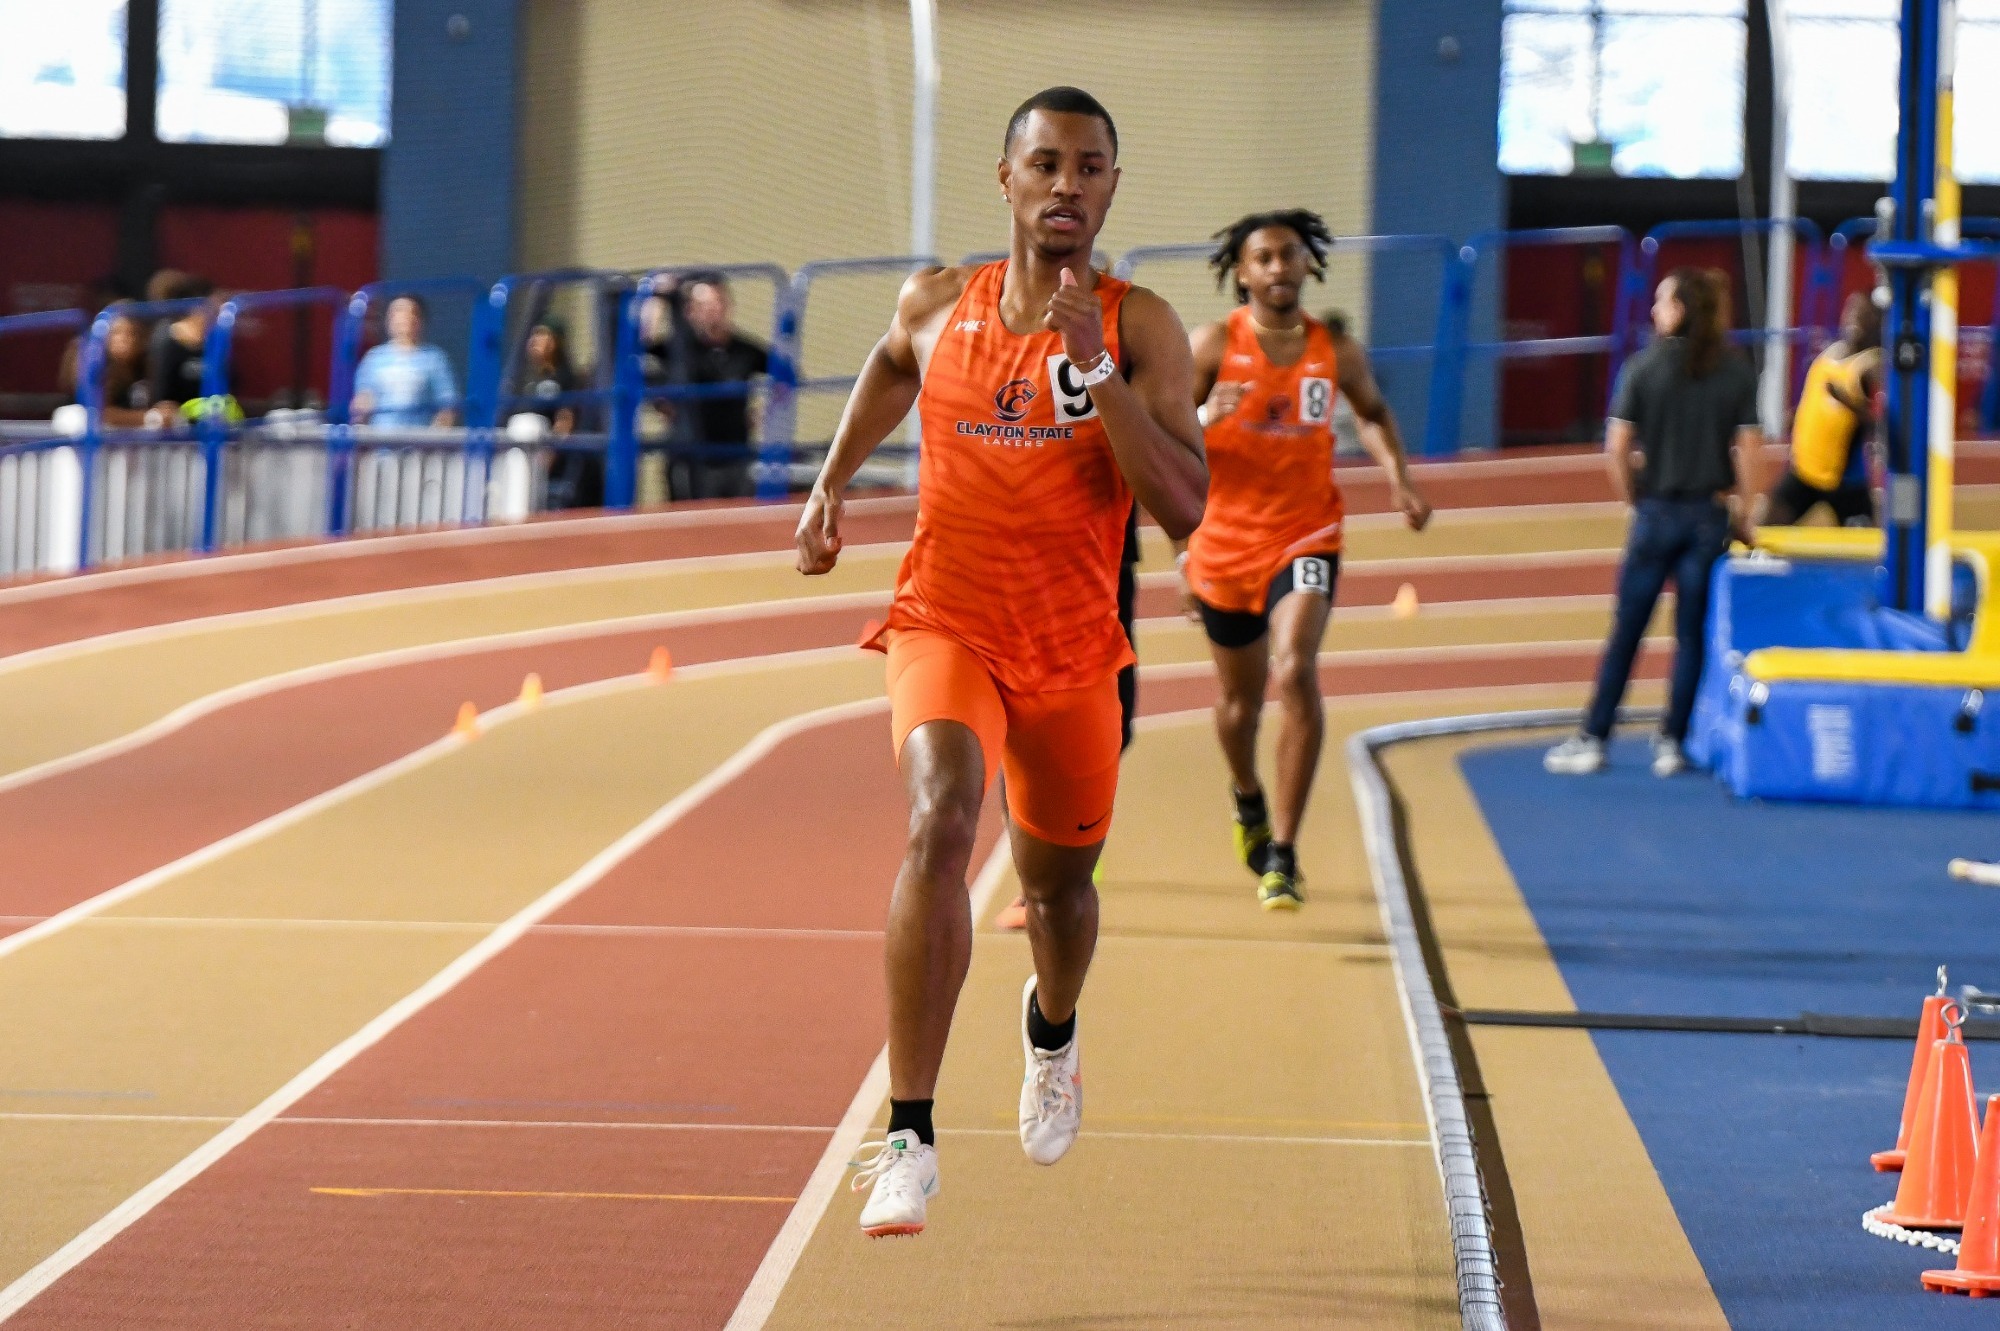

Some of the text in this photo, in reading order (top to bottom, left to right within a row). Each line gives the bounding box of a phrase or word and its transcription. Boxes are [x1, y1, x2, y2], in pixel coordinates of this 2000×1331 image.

[1057, 357, 1094, 417] 9
[1308, 380, 1326, 418] 8
[956, 421, 1074, 439] CLAYTON STATE
[983, 438, 1044, 447] LAKERS
[1303, 559, 1322, 586] 8
